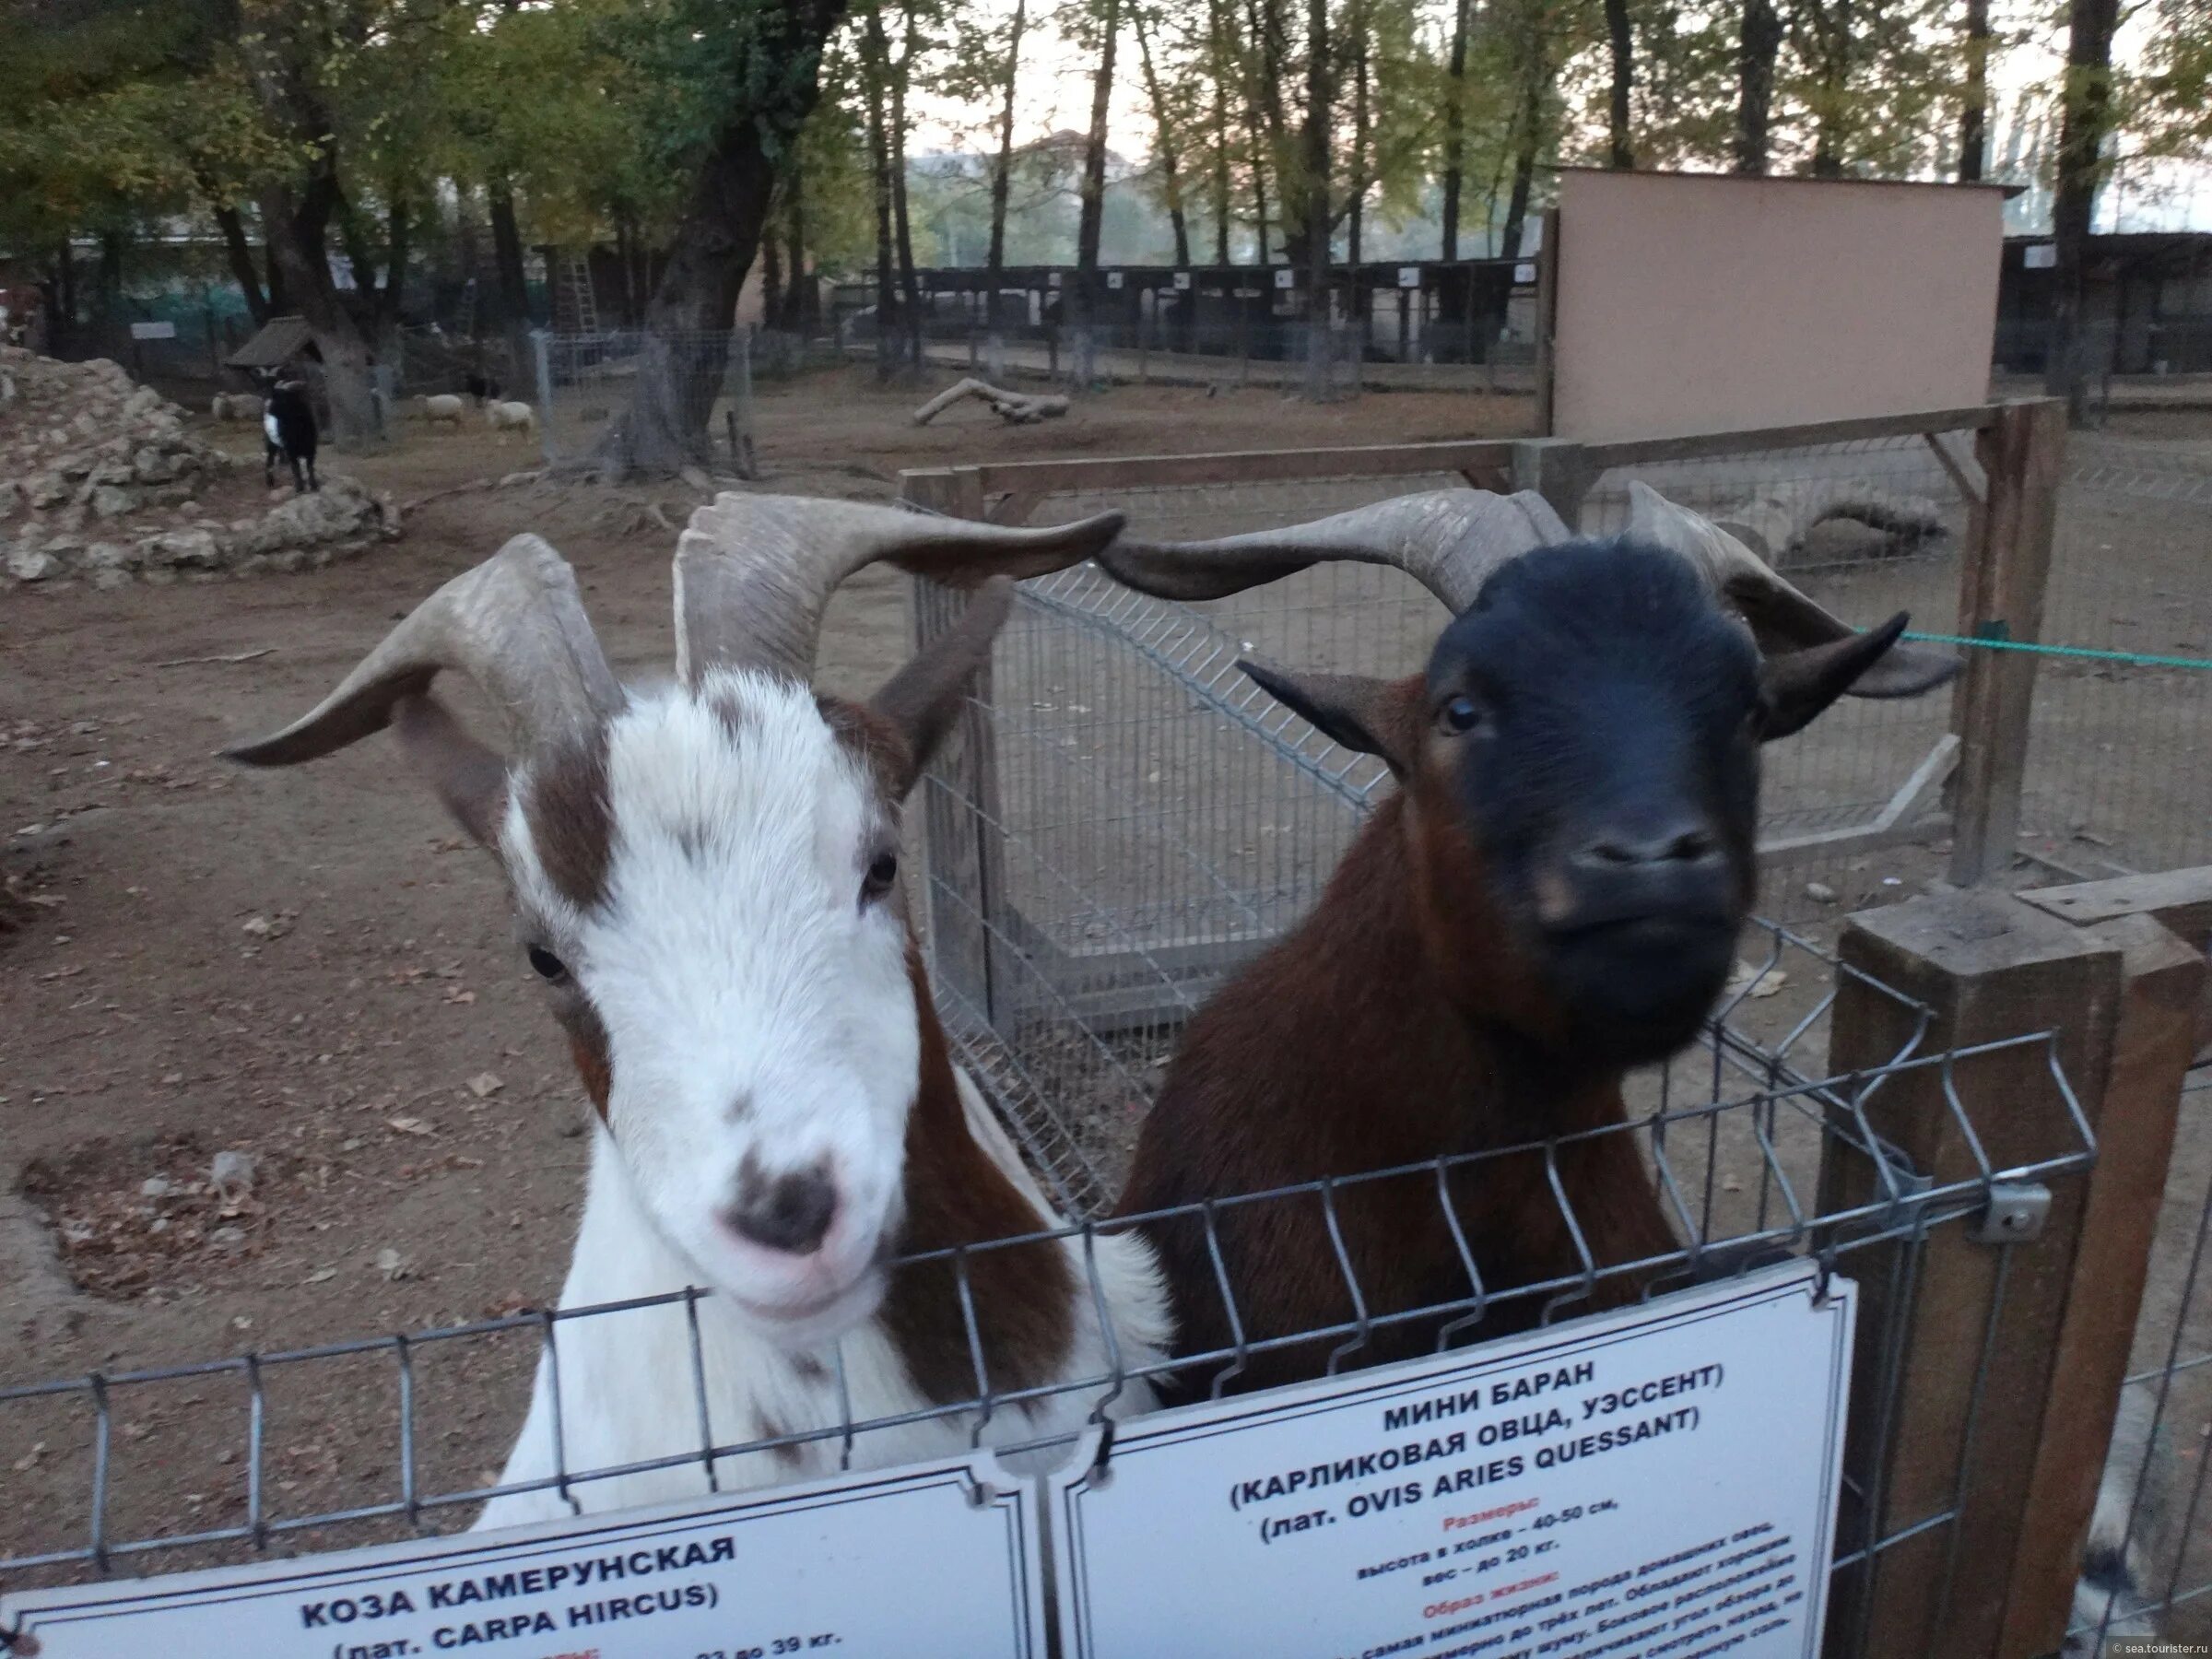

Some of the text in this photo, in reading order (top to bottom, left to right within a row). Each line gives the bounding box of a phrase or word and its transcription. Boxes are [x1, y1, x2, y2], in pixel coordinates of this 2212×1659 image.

[1384, 1361, 1594, 1431] МИНИ БАРАН
[1230, 1362, 1724, 1512] (КАРЛИКОВАЯ ОВЦА, УЭССЕНТ)
[1261, 1406, 1700, 1545] (лат. OVIS ARIES QUESSANT)
[1533, 1505, 1583, 1531] 40-50
[300, 1536, 735, 1628] КОЗА КАМЕРУНСКАЯ
[1422, 1568, 1457, 1586] вес
[1477, 1556, 1500, 1573] до
[1506, 1545, 1529, 1563] 20
[1535, 1539, 1559, 1555] кг.
[433, 1611, 557, 1649] CARPA
[569, 1583, 718, 1628] HIRCUS)
[771, 1636, 800, 1655] 39
[809, 1632, 842, 1648] кг.
